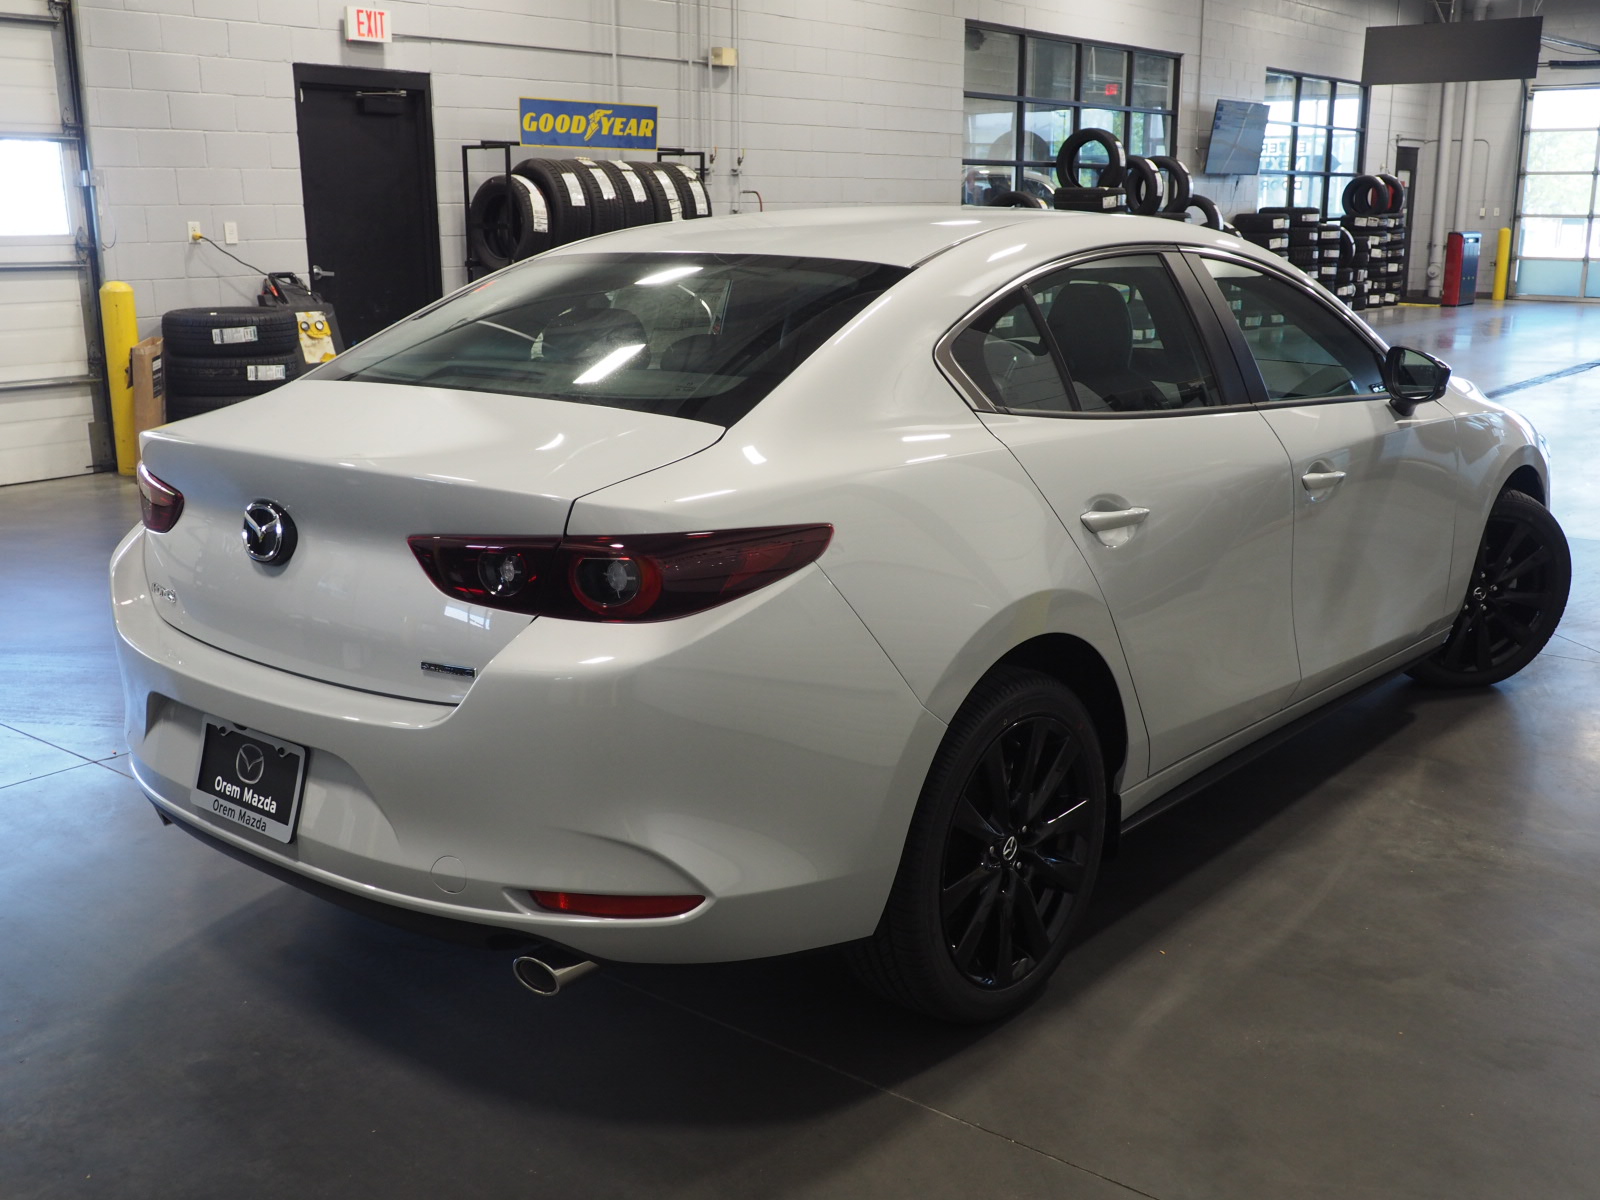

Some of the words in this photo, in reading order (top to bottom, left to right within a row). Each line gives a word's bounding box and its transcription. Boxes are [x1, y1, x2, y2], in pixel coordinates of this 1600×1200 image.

[356, 9, 385, 39] EXIT
[214, 775, 241, 799] Orem
[242, 786, 277, 814] Mazda
[212, 798, 236, 819] Orem
[237, 809, 267, 832] Mazda
